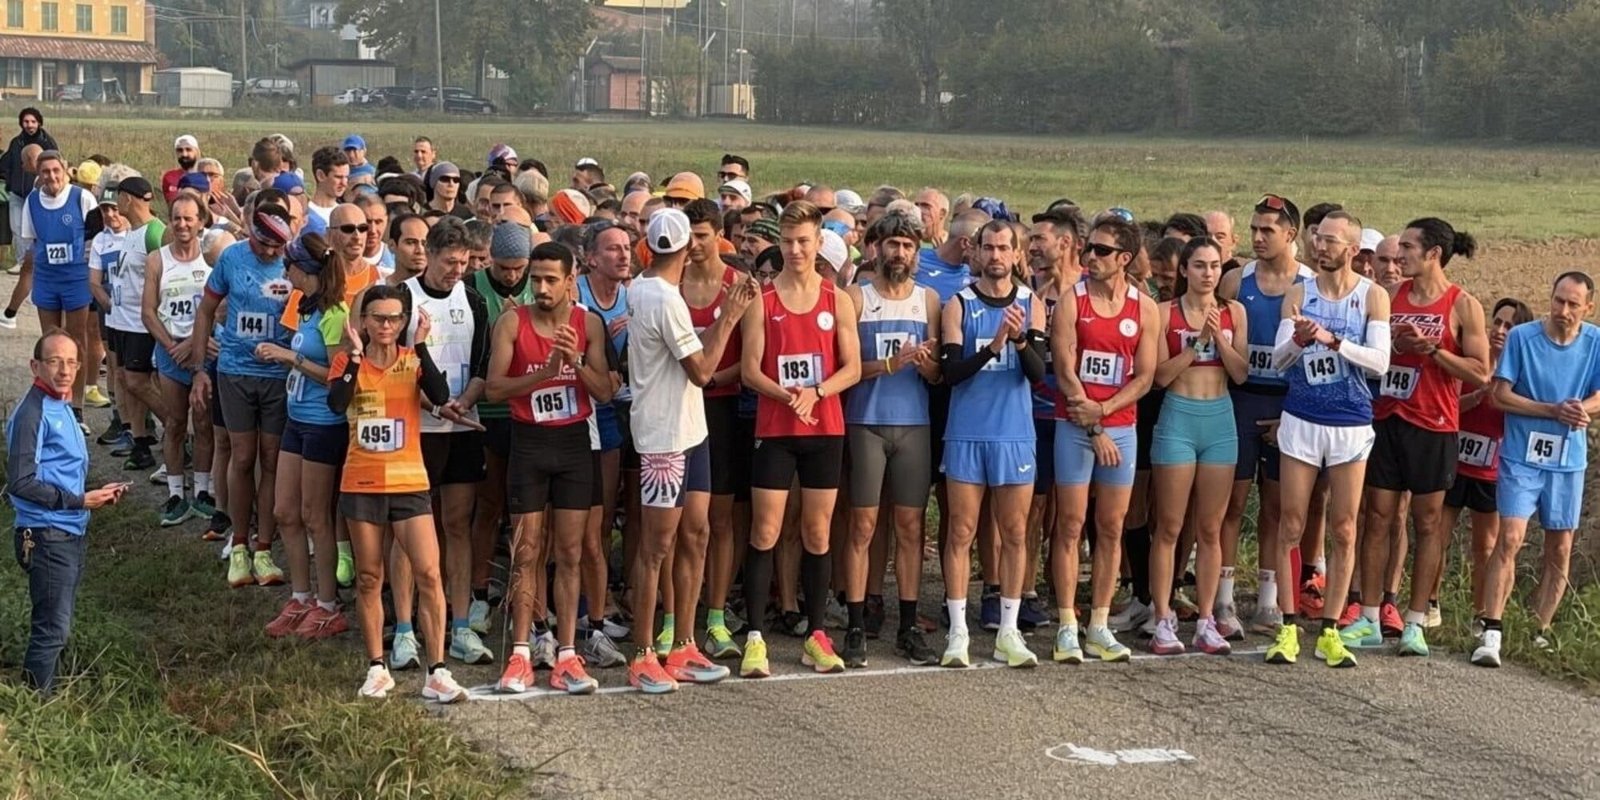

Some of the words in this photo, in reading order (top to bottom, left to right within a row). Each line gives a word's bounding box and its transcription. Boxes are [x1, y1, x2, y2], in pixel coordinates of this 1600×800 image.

[170, 300, 192, 316] 242
[241, 316, 263, 333] 144
[1390, 313, 1444, 325] TLETICA
[1086, 356, 1111, 376] 155
[1250, 350, 1273, 369] 497
[1308, 356, 1336, 378] 143
[782, 360, 809, 380] 183
[1386, 371, 1410, 390] 148
[535, 392, 564, 414] 185
[361, 425, 391, 443] 495
[1459, 437, 1483, 457] 197
[1534, 439, 1554, 457] 45
